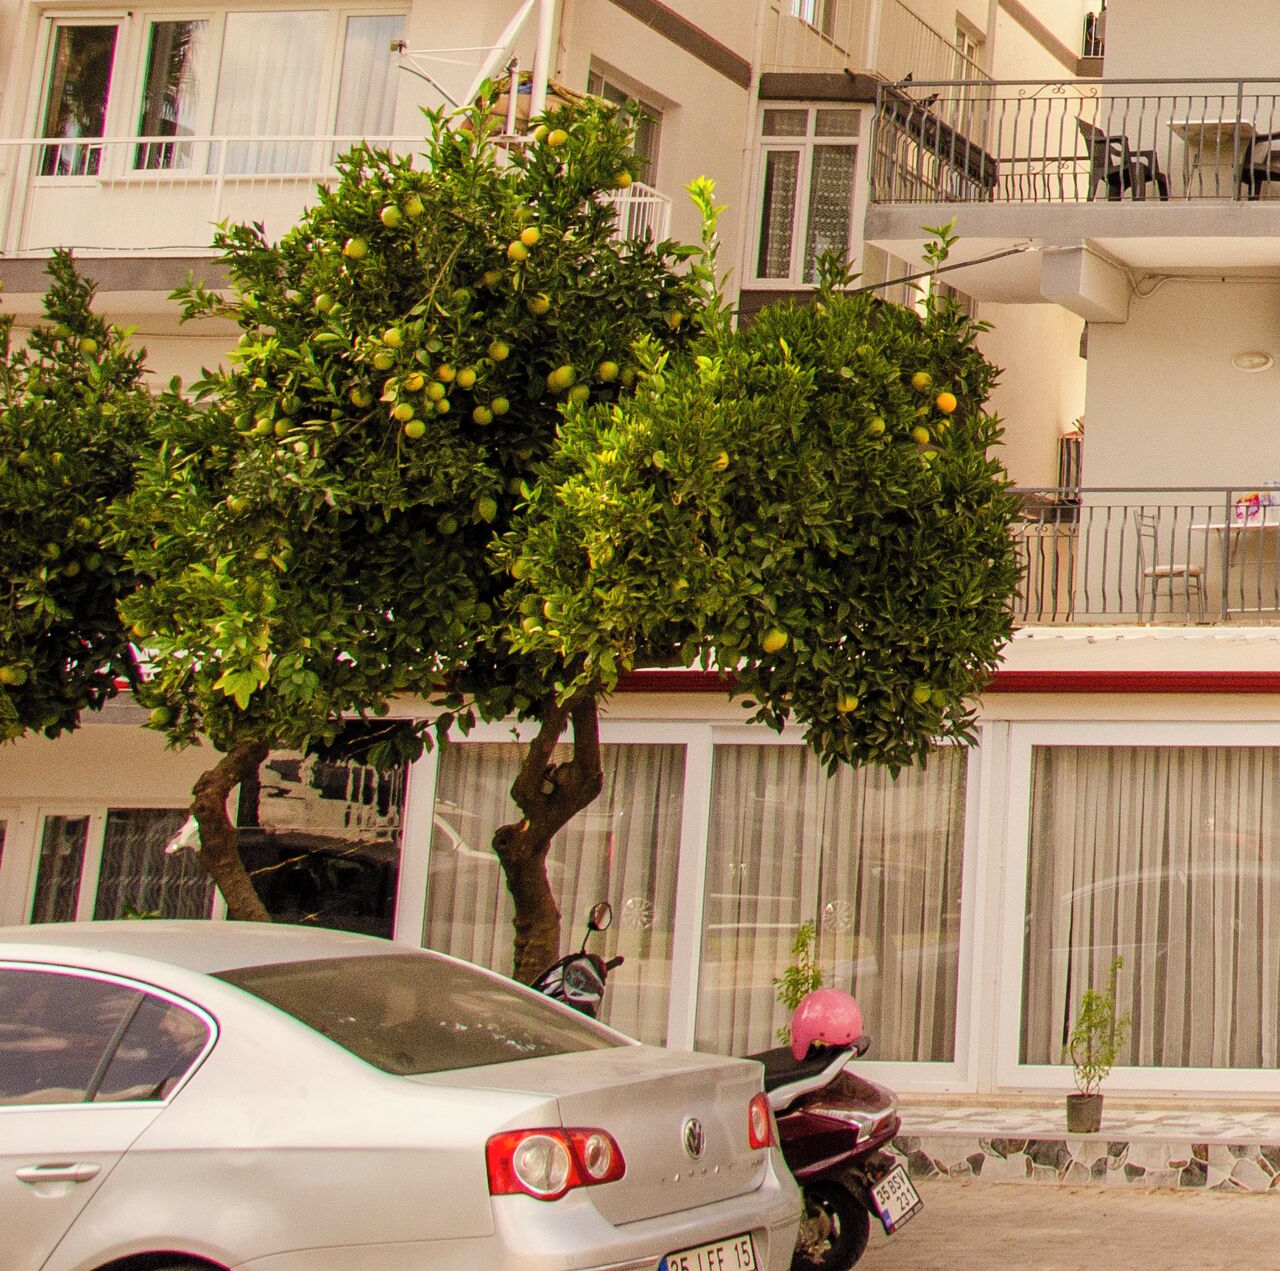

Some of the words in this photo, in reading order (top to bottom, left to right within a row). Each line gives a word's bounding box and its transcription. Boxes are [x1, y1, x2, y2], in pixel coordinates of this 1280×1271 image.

[876, 1185, 891, 1205] 35
[896, 1187, 915, 1211] 231
[734, 1240, 751, 1269] 15
